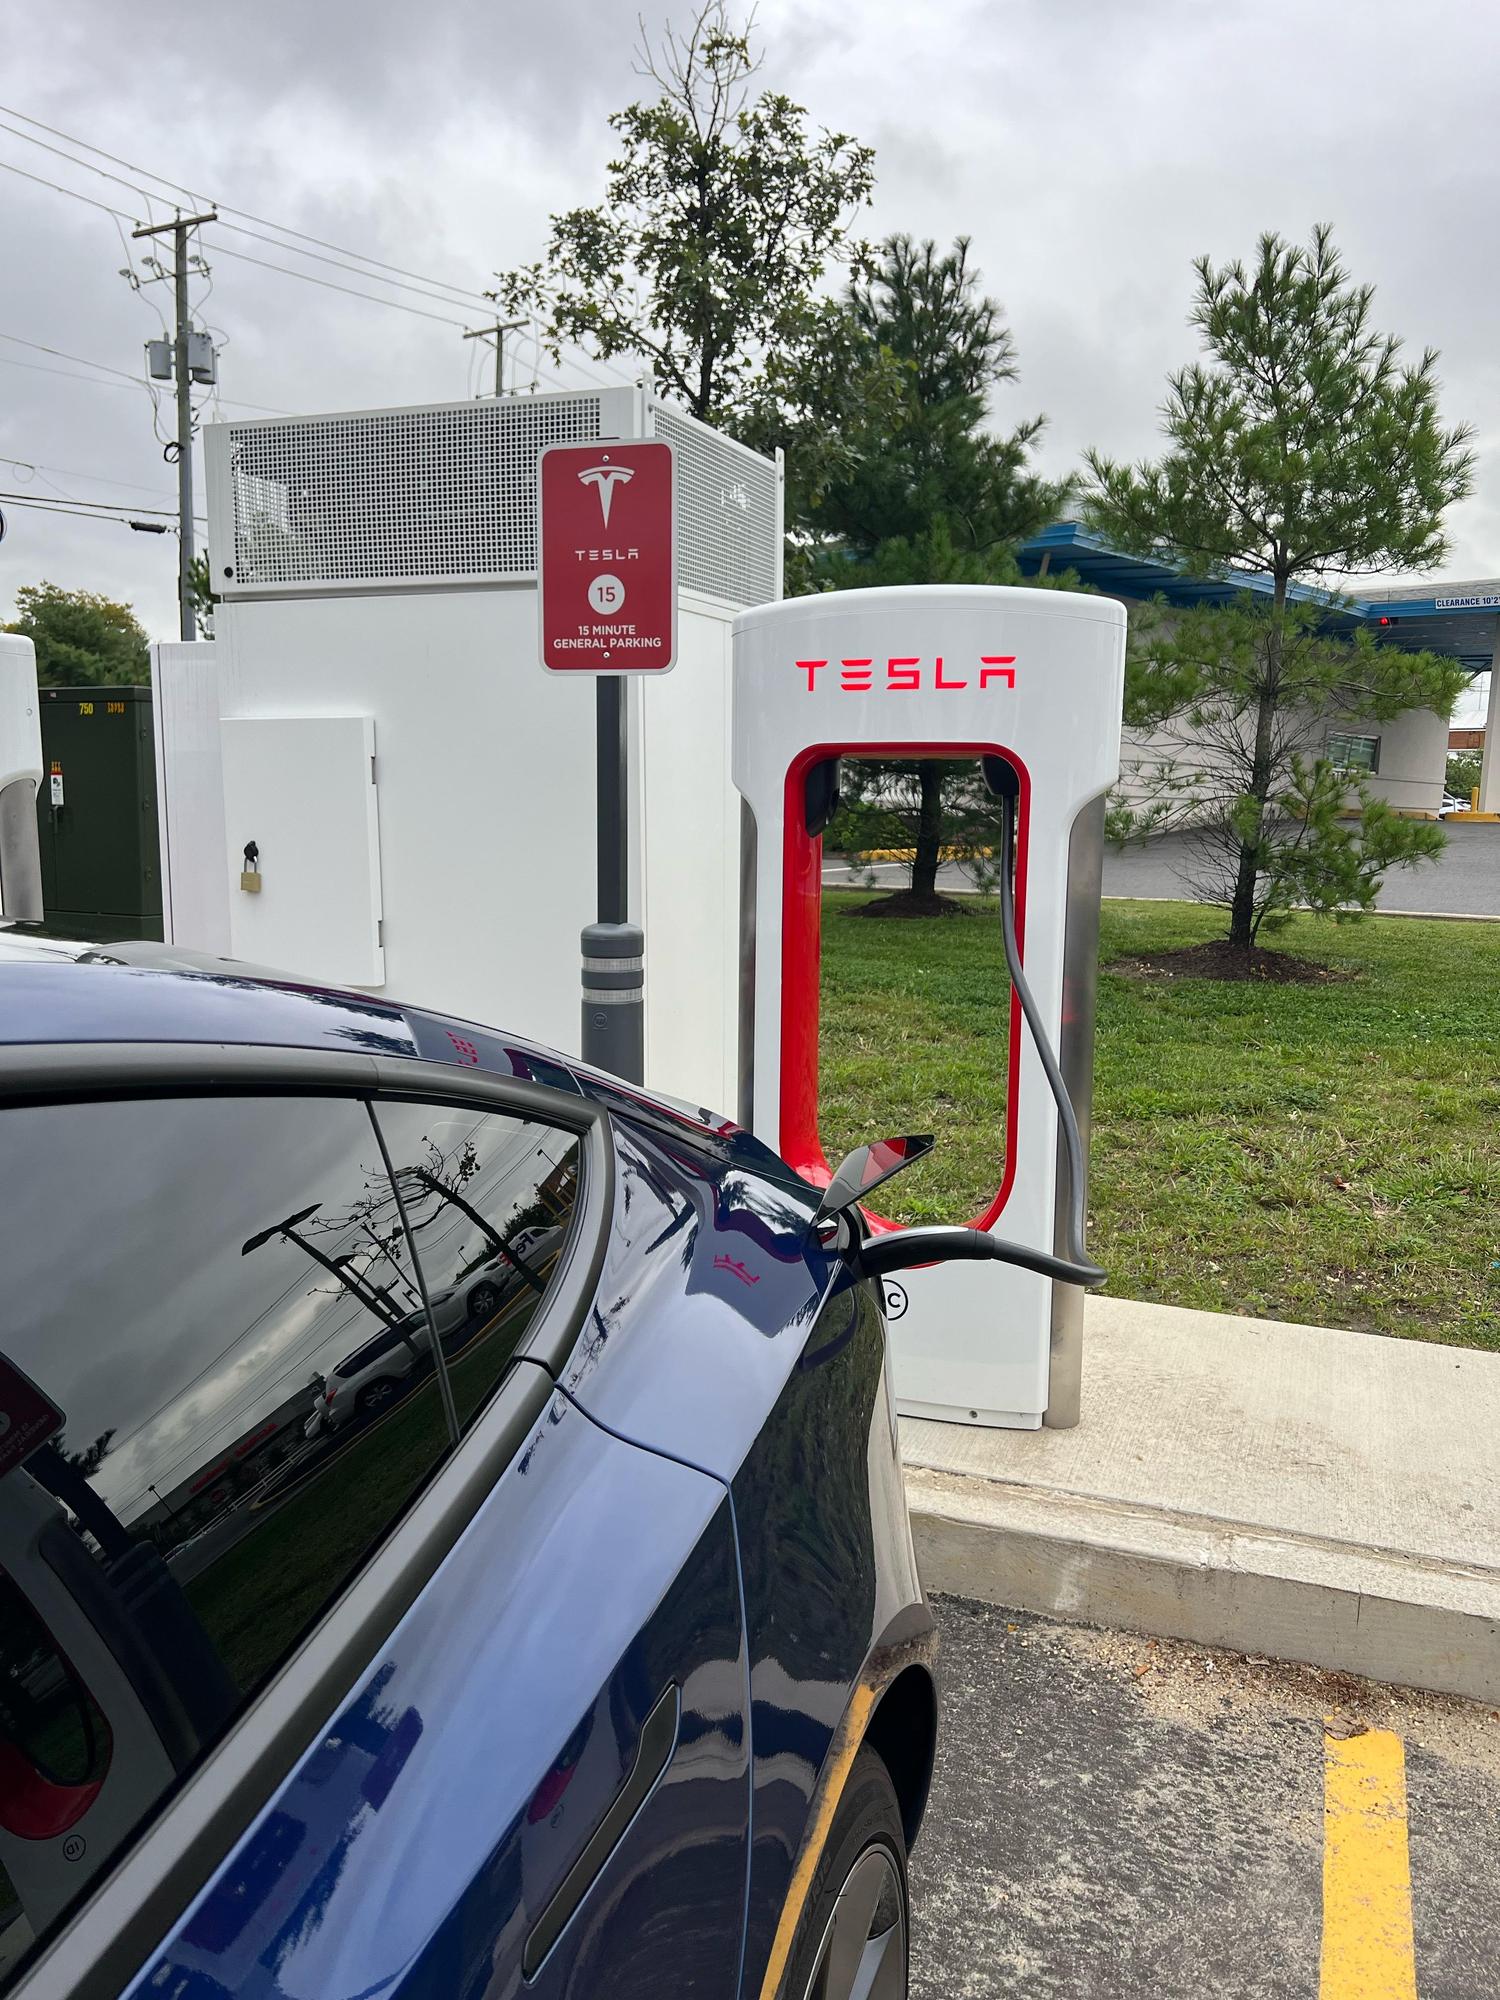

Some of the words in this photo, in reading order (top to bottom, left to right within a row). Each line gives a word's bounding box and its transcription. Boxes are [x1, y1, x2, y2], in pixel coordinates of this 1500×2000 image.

[574, 548, 639, 561] TESLA
[597, 586, 616, 603] 15
[1436, 598, 1480, 608] CLEARANCE
[578, 625, 590, 636] 15
[592, 624, 637, 636] MINUTE
[553, 638, 607, 649] GENERAL
[610, 637, 662, 648] PARKING
[795, 656, 1017, 692] TESLA
[79, 702, 94, 715] 750
